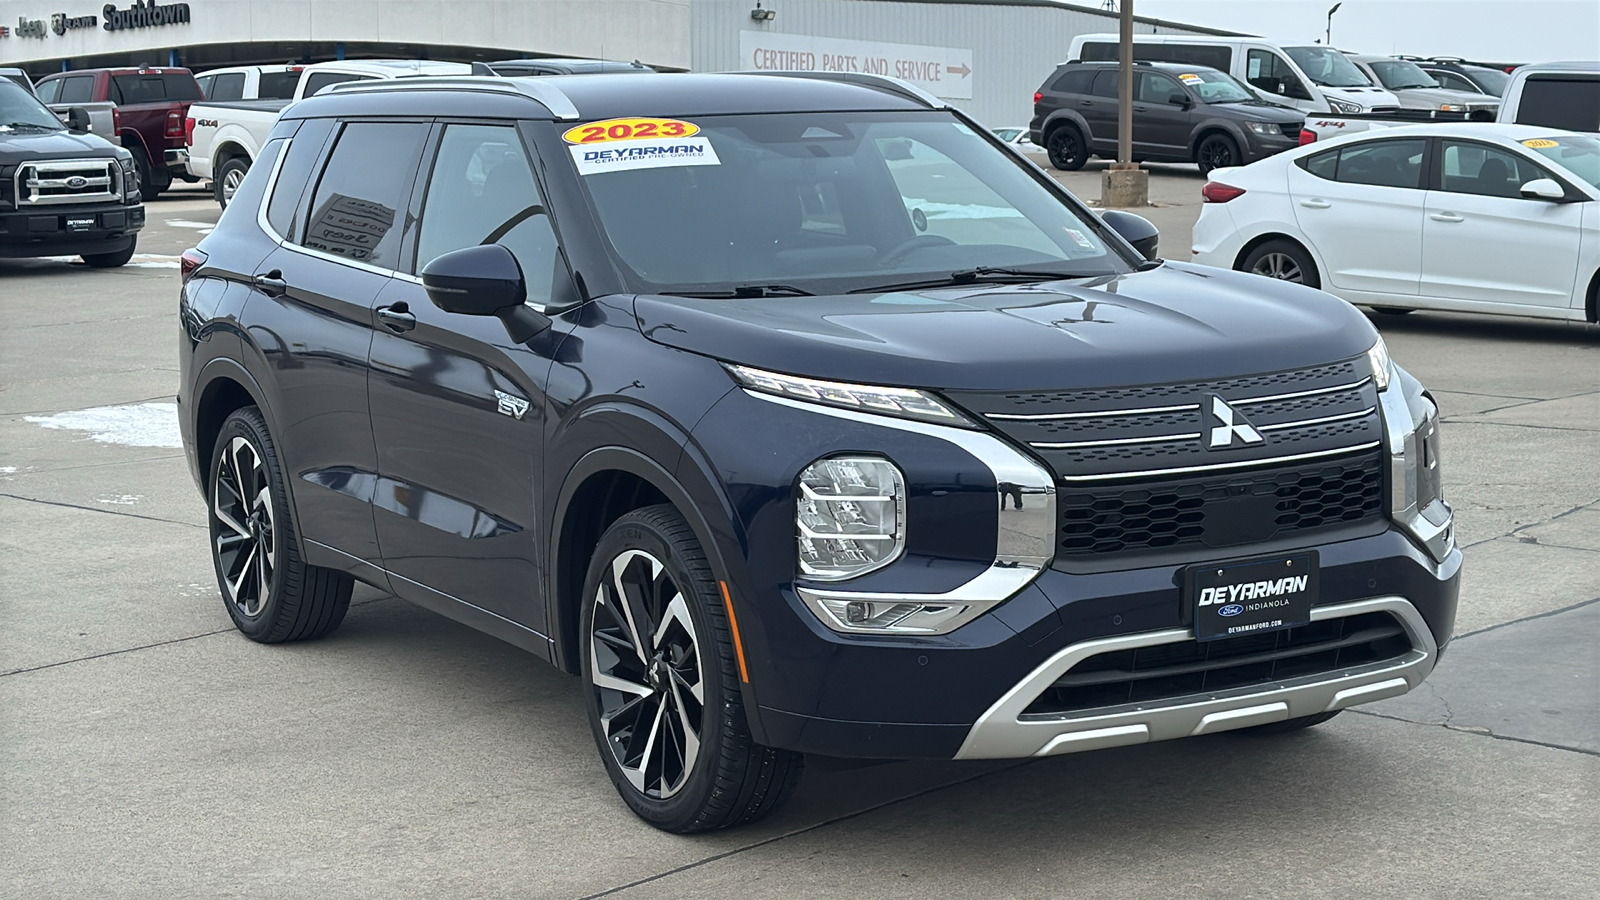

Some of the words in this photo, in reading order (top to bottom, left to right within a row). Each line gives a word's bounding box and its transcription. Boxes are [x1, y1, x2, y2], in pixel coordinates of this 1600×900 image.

[15, 16, 47, 40] Jeep
[63, 16, 97, 30] RAM
[103, 0, 190, 31] Southtown
[753, 47, 815, 71] CERTIFIED
[823, 54, 857, 72] PARTS
[863, 57, 888, 76] AND
[895, 60, 941, 81] SERVICE
[581, 122, 687, 142] 2023
[584, 145, 703, 161] DEYARMAN
[595, 155, 645, 164] CERTIFIED
[1199, 575, 1308, 606] DEYARMAN
[1222, 605, 1239, 615] Ford
[1245, 599, 1290, 612] INDIANOLA
[1228, 620, 1282, 634] DEYARMANFORD.COM
